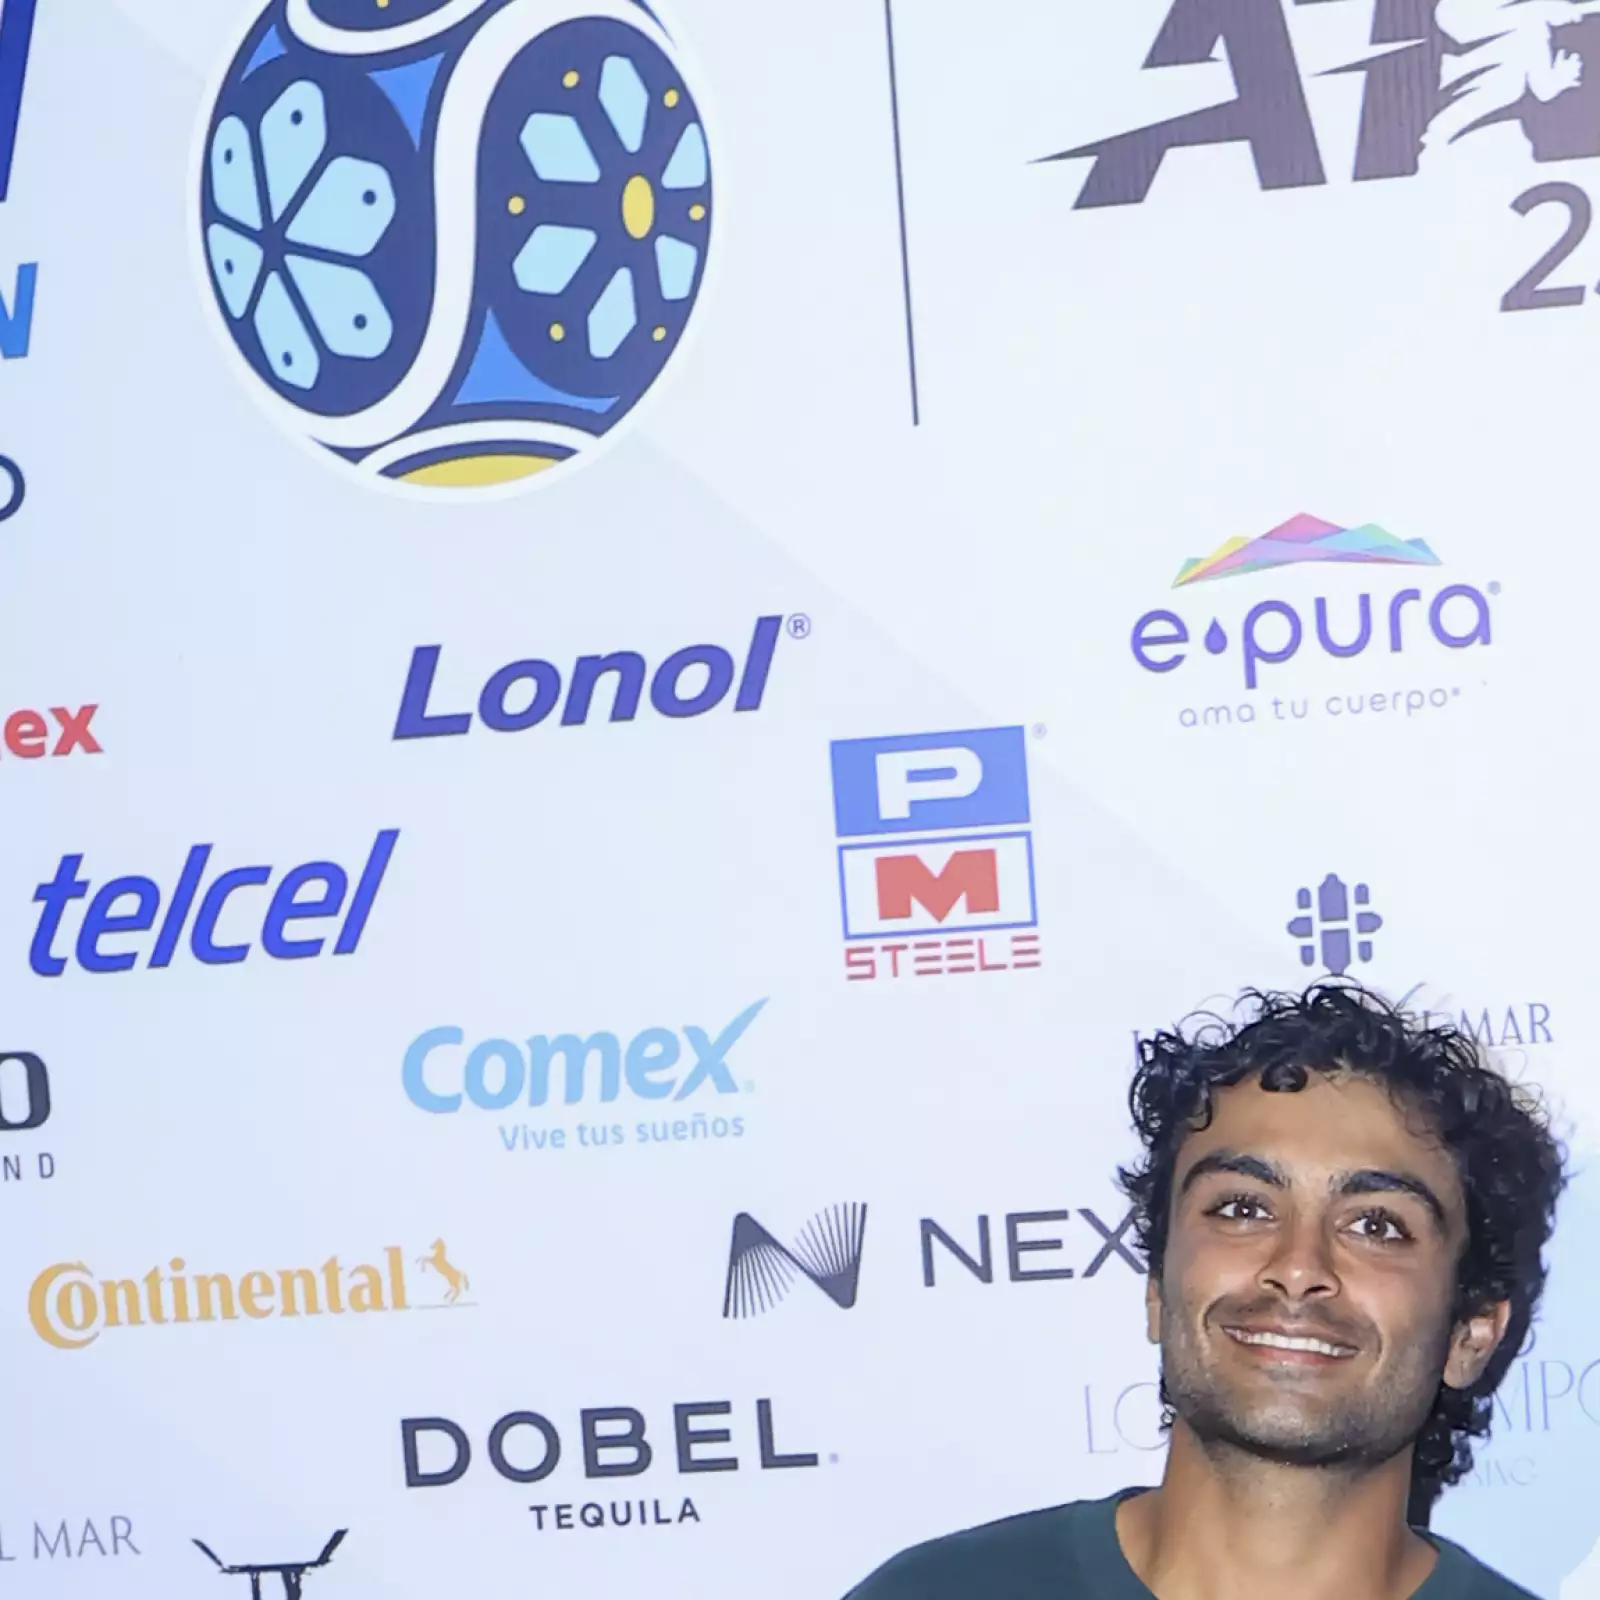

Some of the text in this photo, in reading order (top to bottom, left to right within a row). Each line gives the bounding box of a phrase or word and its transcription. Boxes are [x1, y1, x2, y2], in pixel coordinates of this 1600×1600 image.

[392, 615, 783, 740] Lonol
[2, 703, 103, 758] ex
[1179, 684, 1450, 729] ama tu cuerpo
[28, 828, 401, 977] telcel
[845, 935, 1041, 981] STEELE
[401, 996, 770, 1113] Comex
[499, 1111, 745, 1152] Vive tus sueños
[28, 1245, 407, 1350] Continental
[401, 1398, 819, 1488] DOBEL
[34, 1516, 141, 1560] MAR
[530, 1498, 701, 1532] TEQUILA
